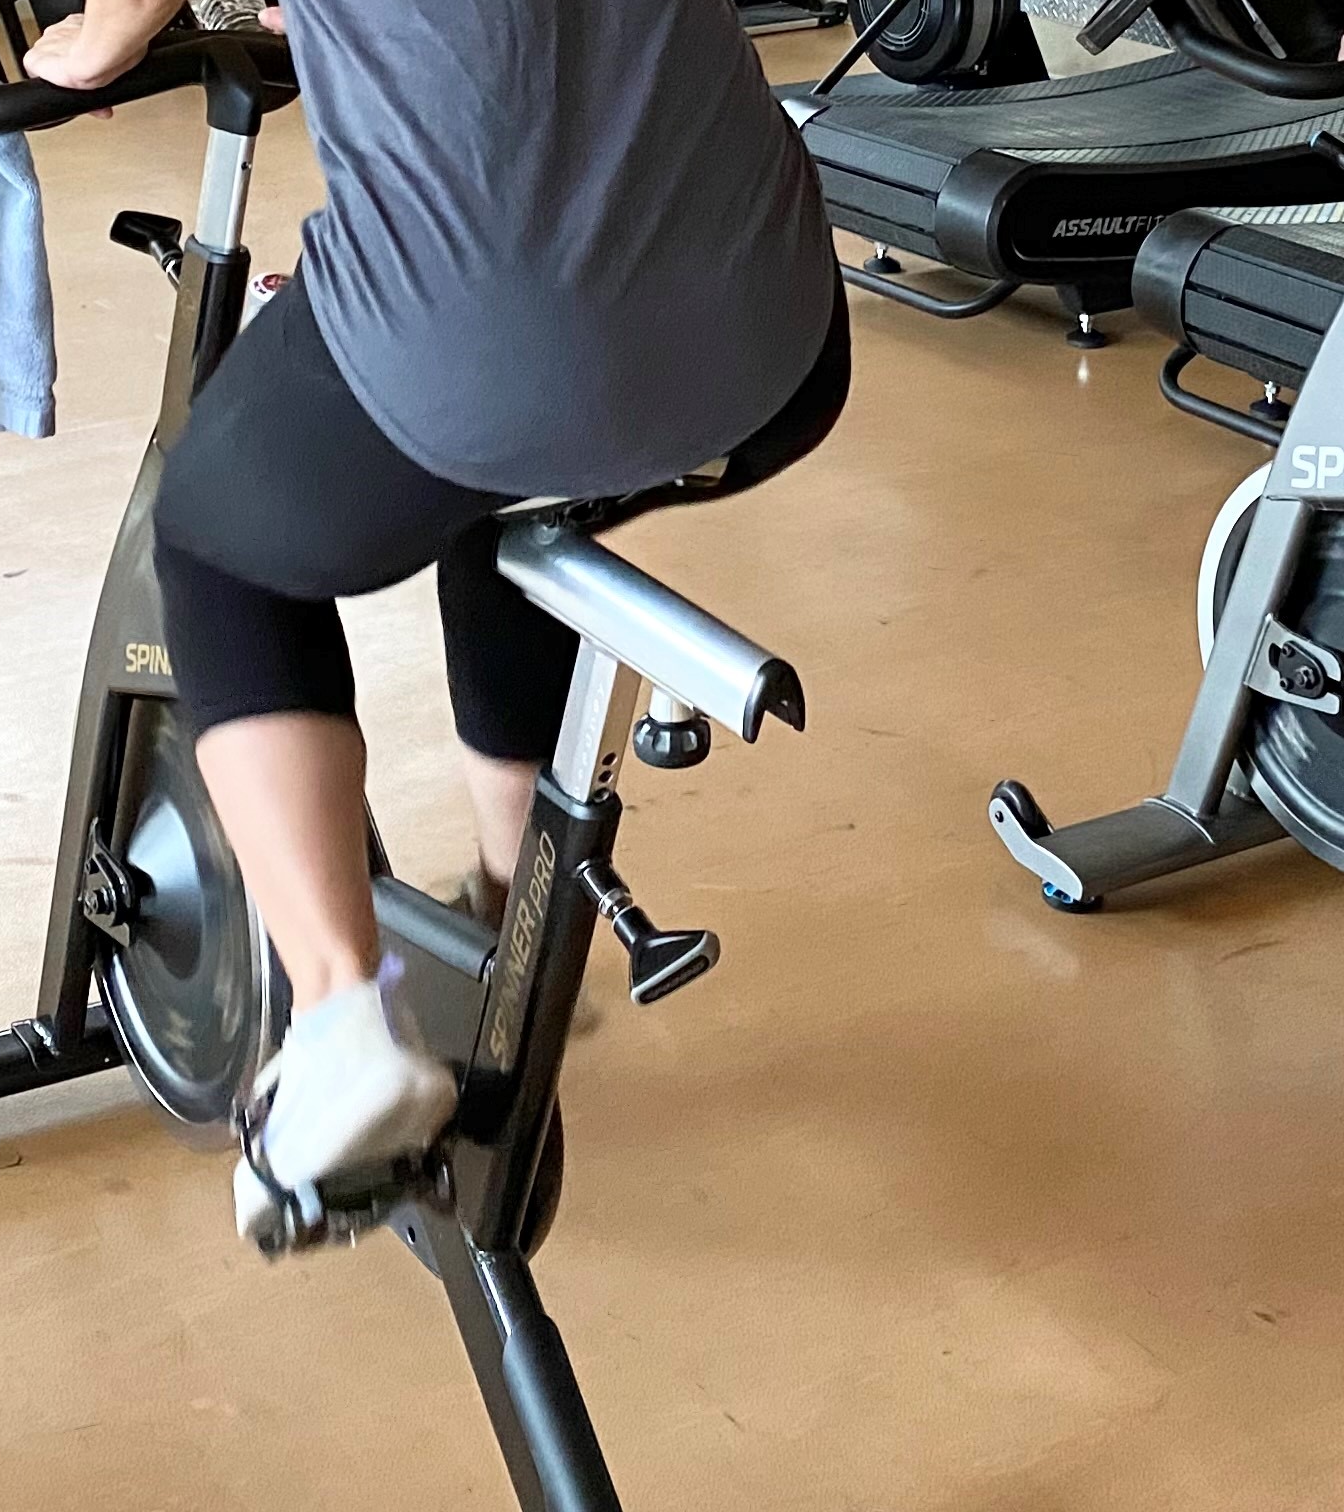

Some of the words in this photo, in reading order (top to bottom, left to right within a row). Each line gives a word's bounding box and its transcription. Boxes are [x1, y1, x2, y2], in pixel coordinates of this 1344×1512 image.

[1052, 214, 1165, 238] ASSAULTFIT
[125, 642, 173, 677] SPIN
[529, 830, 556, 918] PRO
